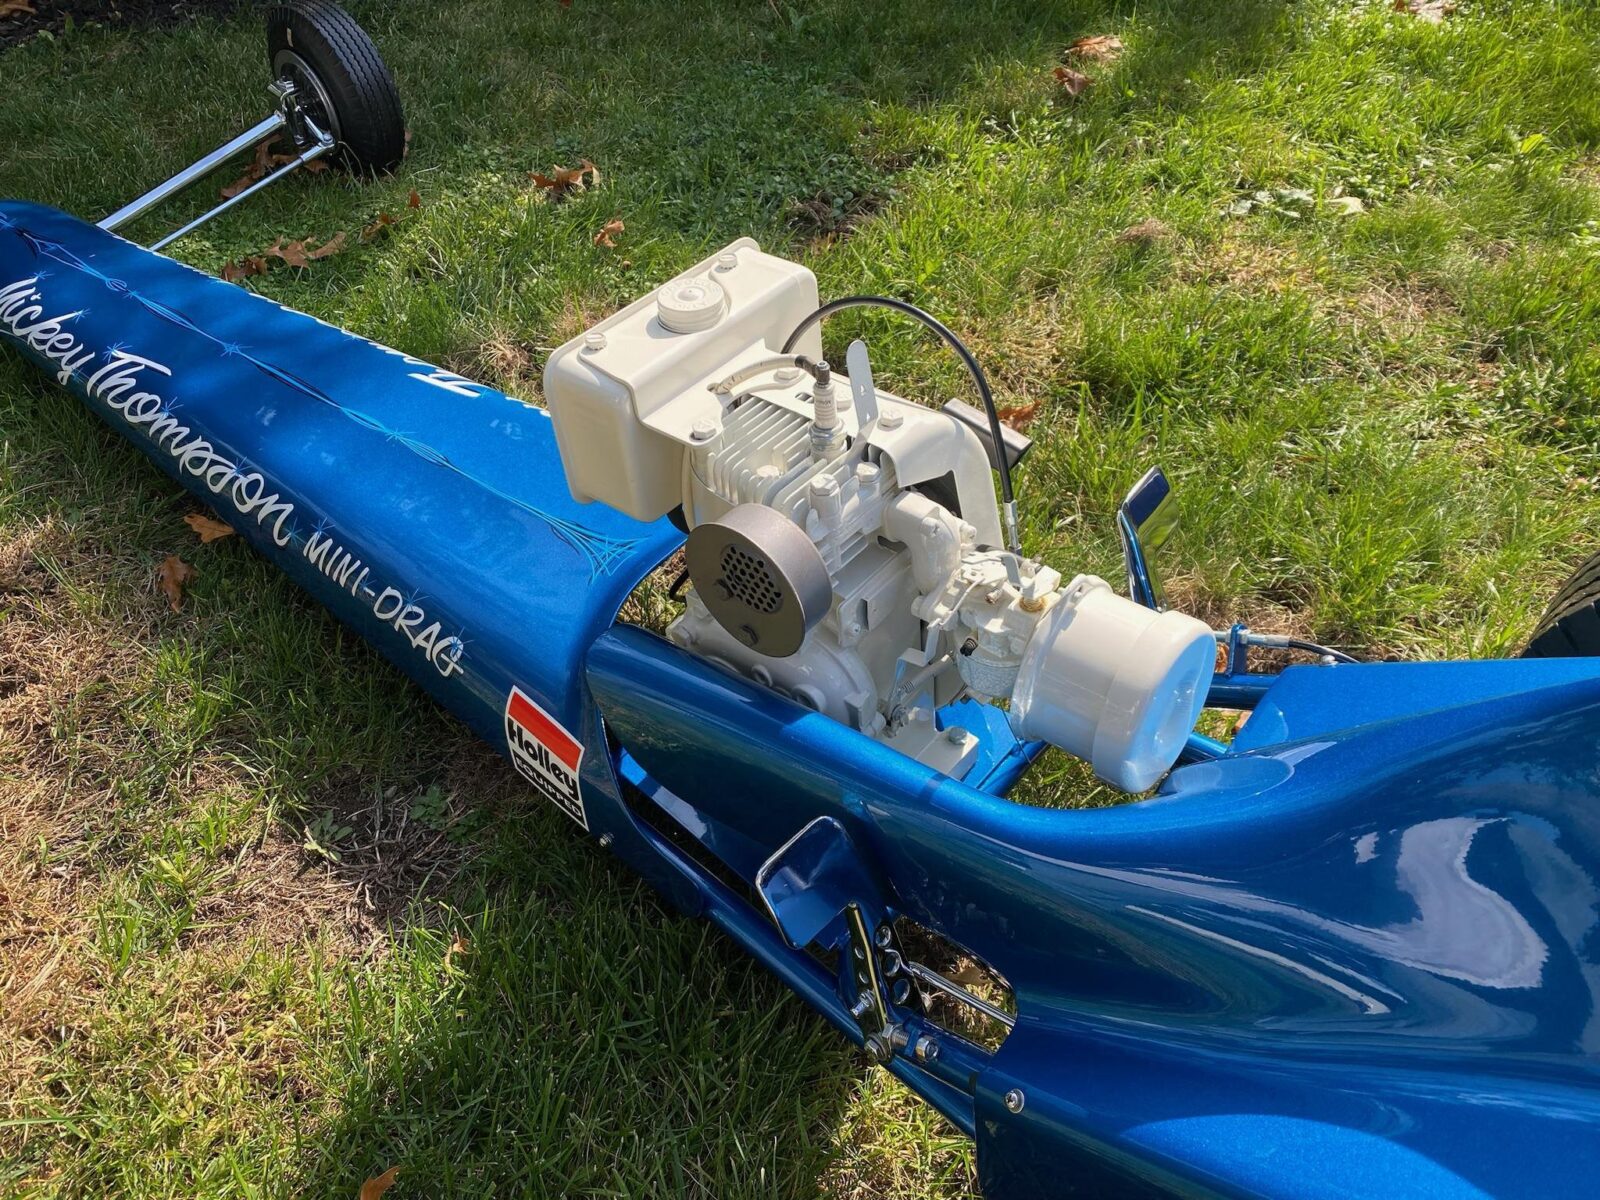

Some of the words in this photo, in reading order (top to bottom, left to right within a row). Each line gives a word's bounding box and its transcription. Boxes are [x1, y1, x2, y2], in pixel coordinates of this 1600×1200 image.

[86, 349, 294, 546] Thompson
[302, 530, 464, 677] MINI-DRAG
[507, 716, 580, 802] Holley
[515, 756, 582, 817] EQUIPPED
